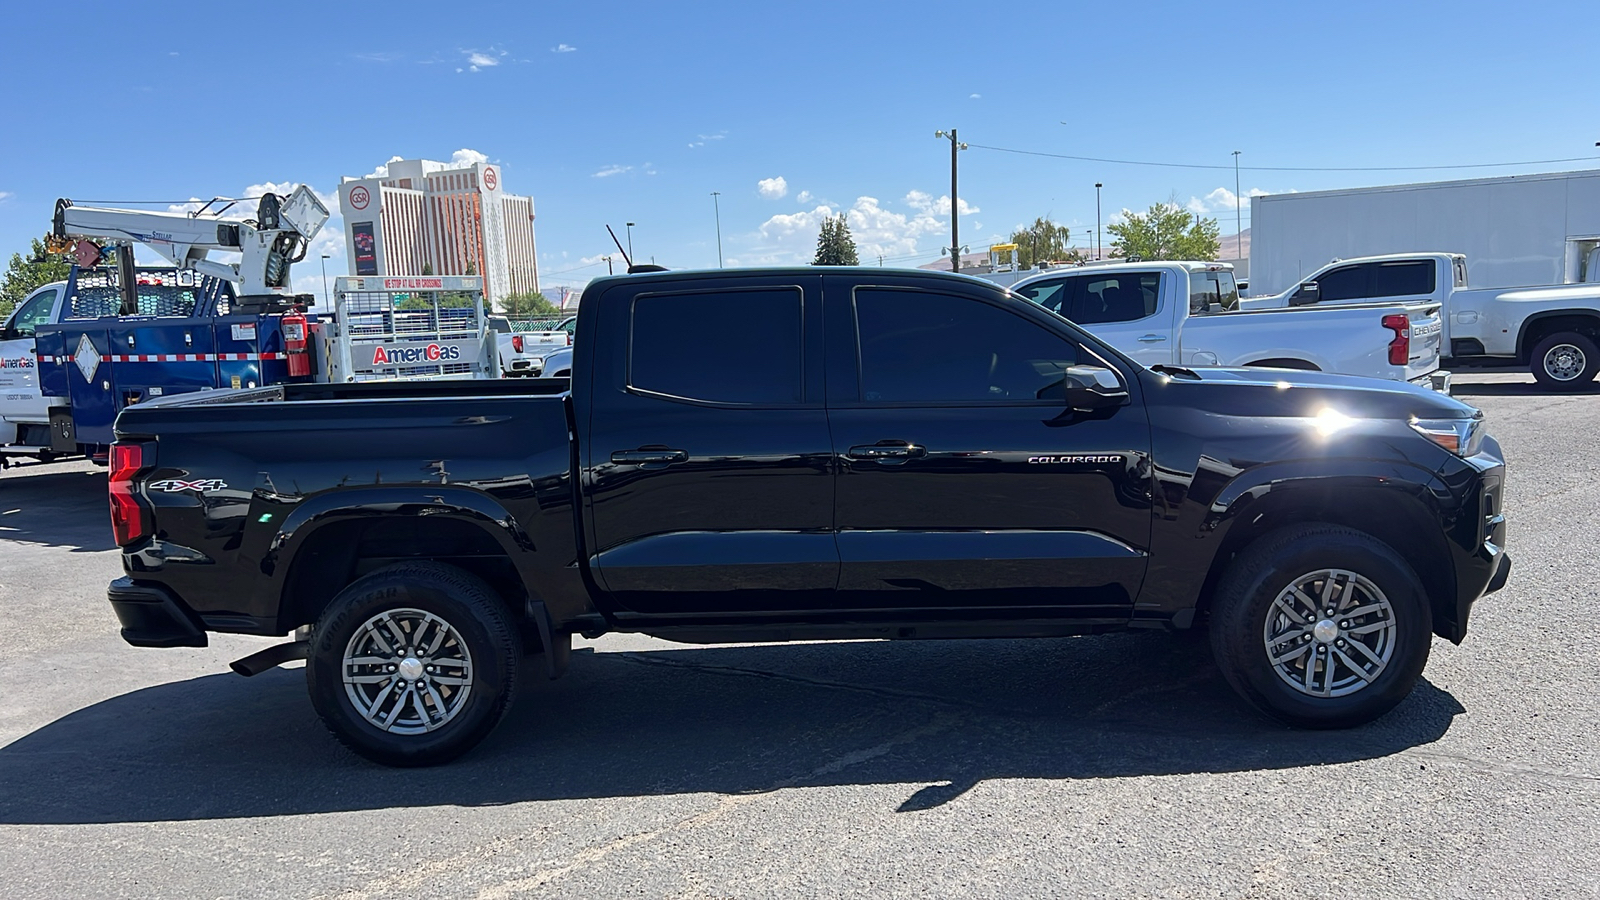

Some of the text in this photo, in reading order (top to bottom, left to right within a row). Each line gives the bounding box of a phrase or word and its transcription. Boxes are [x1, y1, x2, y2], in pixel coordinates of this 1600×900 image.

[352, 192, 367, 204] GSR
[384, 279, 391, 288] WE
[391, 279, 401, 288] STOP
[402, 279, 407, 288] AT
[415, 279, 421, 288] RR
[421, 279, 442, 288] CROSSINGS
[373, 344, 460, 364] AmeriGas
[0, 357, 34, 368] AmeriGas
[1028, 456, 1121, 464] COLORADO
